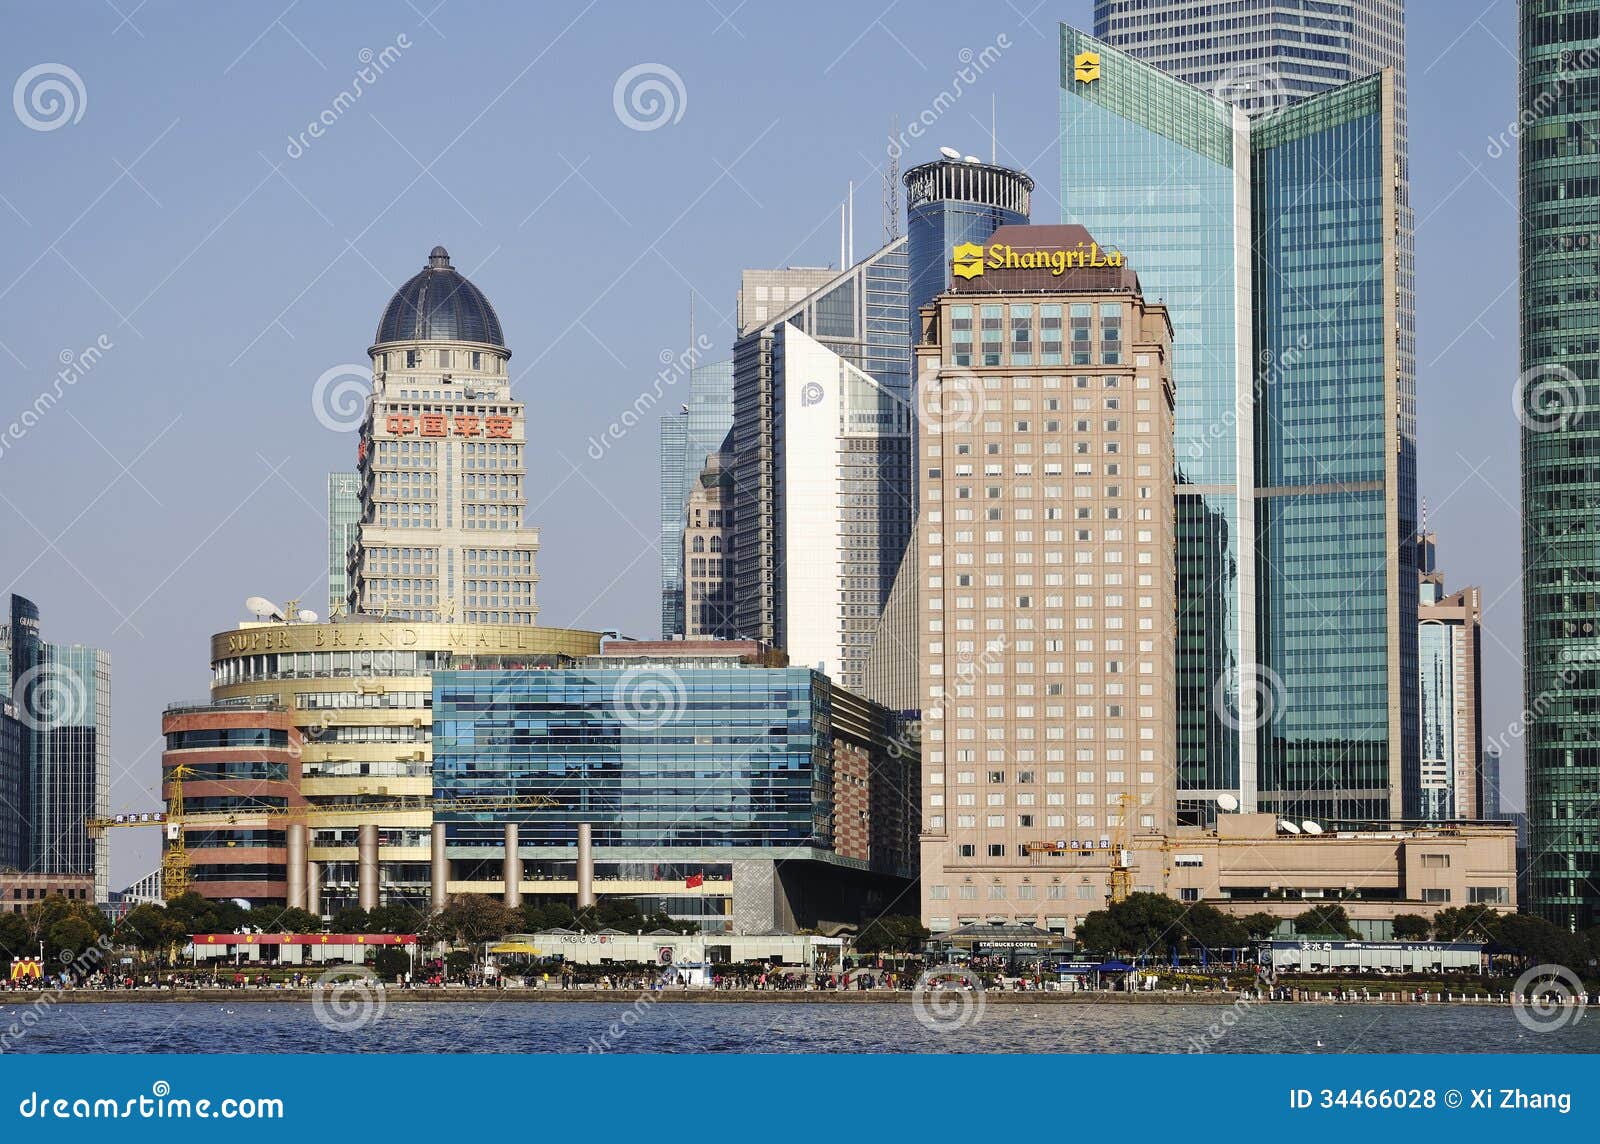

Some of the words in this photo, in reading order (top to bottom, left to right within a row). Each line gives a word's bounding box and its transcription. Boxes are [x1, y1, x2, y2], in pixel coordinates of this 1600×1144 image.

[987, 241, 1122, 276] Shangri-La
[386, 413, 513, 439] 中国平安
[228, 630, 290, 653] SUPER
[314, 628, 418, 647] BRAND
[448, 630, 528, 649] MALL
